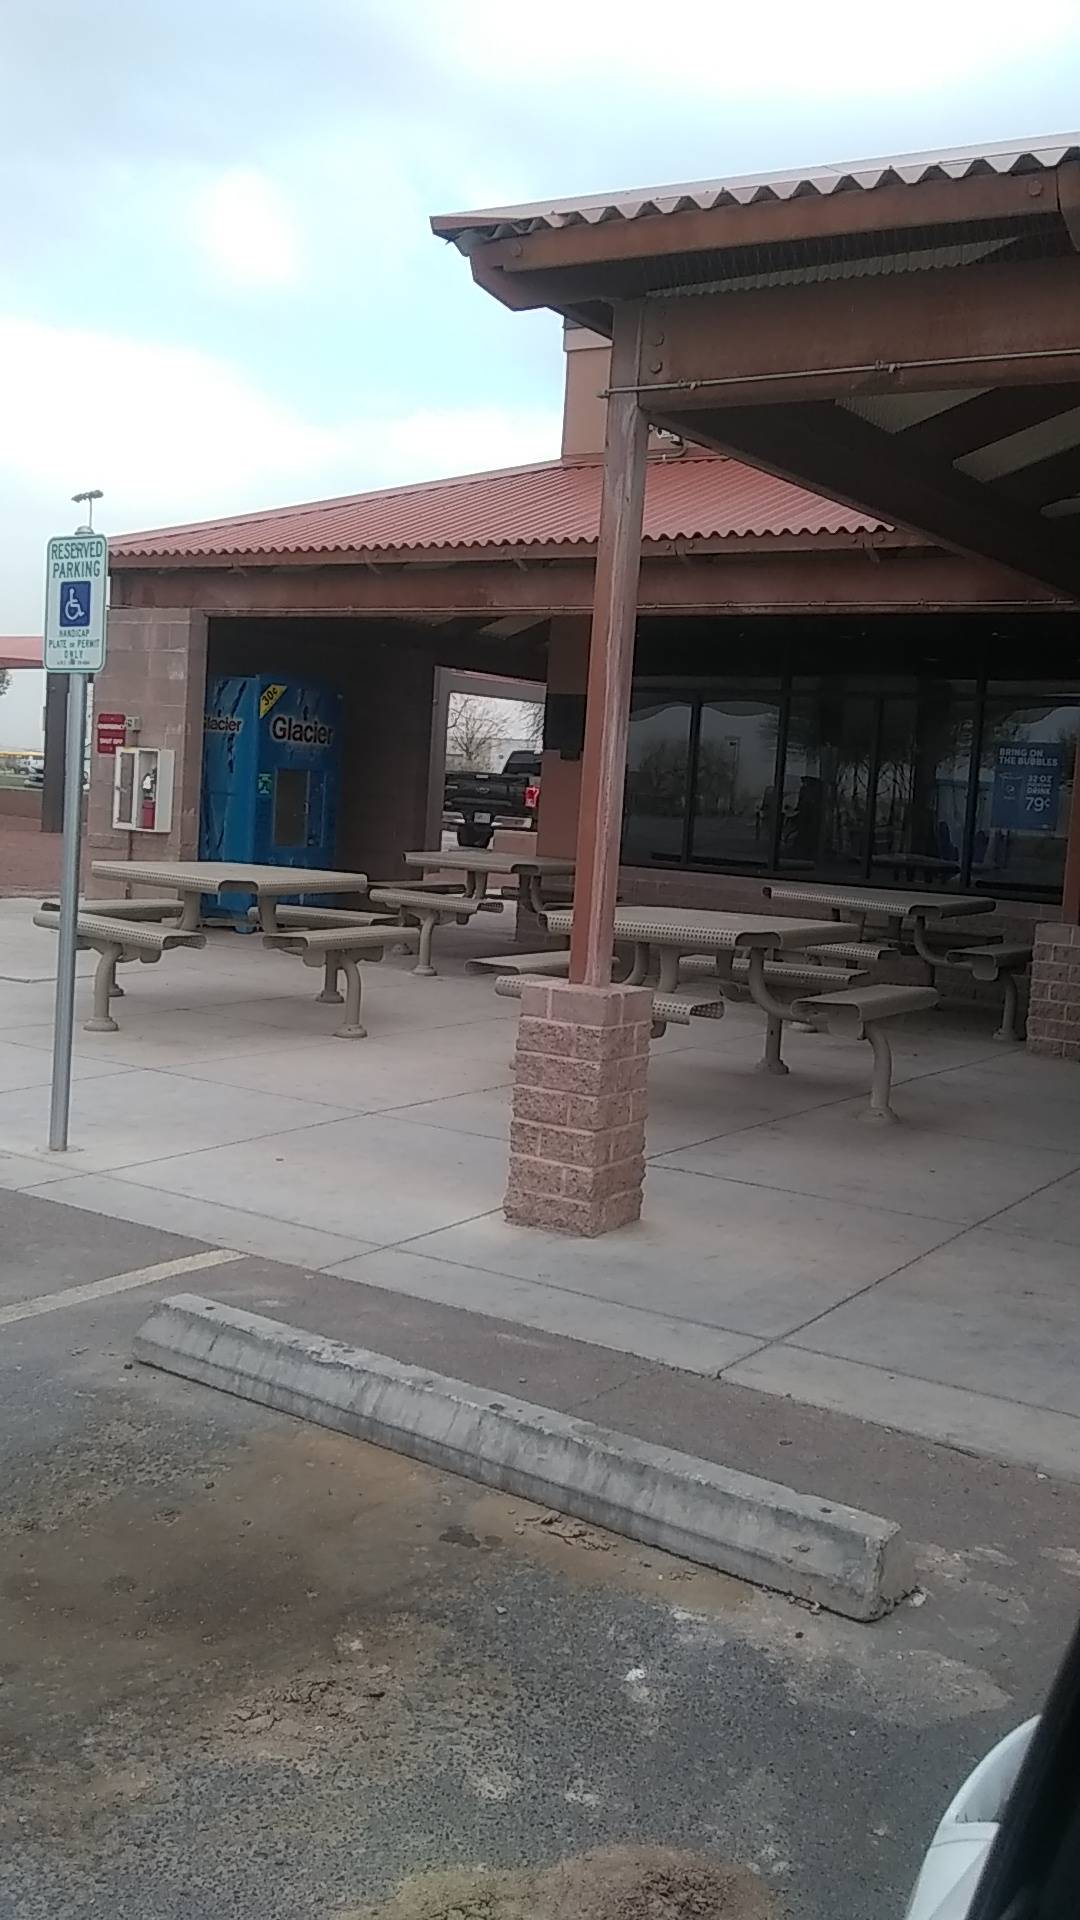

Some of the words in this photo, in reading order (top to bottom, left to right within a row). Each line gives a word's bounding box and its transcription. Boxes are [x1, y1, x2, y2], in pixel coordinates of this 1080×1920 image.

[51, 541, 103, 560] RESERVED
[53, 560, 101, 578] PARKING
[48, 639, 67, 648] PLATE
[64, 650, 83, 659] ONLY
[261, 687, 279, 706] 30¢
[203, 716, 242, 732] lacier
[272, 716, 333, 744] Glacier
[999, 747, 1027, 757] BRING
[1029, 749, 1044, 757] ON
[999, 757, 1016, 765] THE
[1017, 757, 1058, 766] BUBBLES
